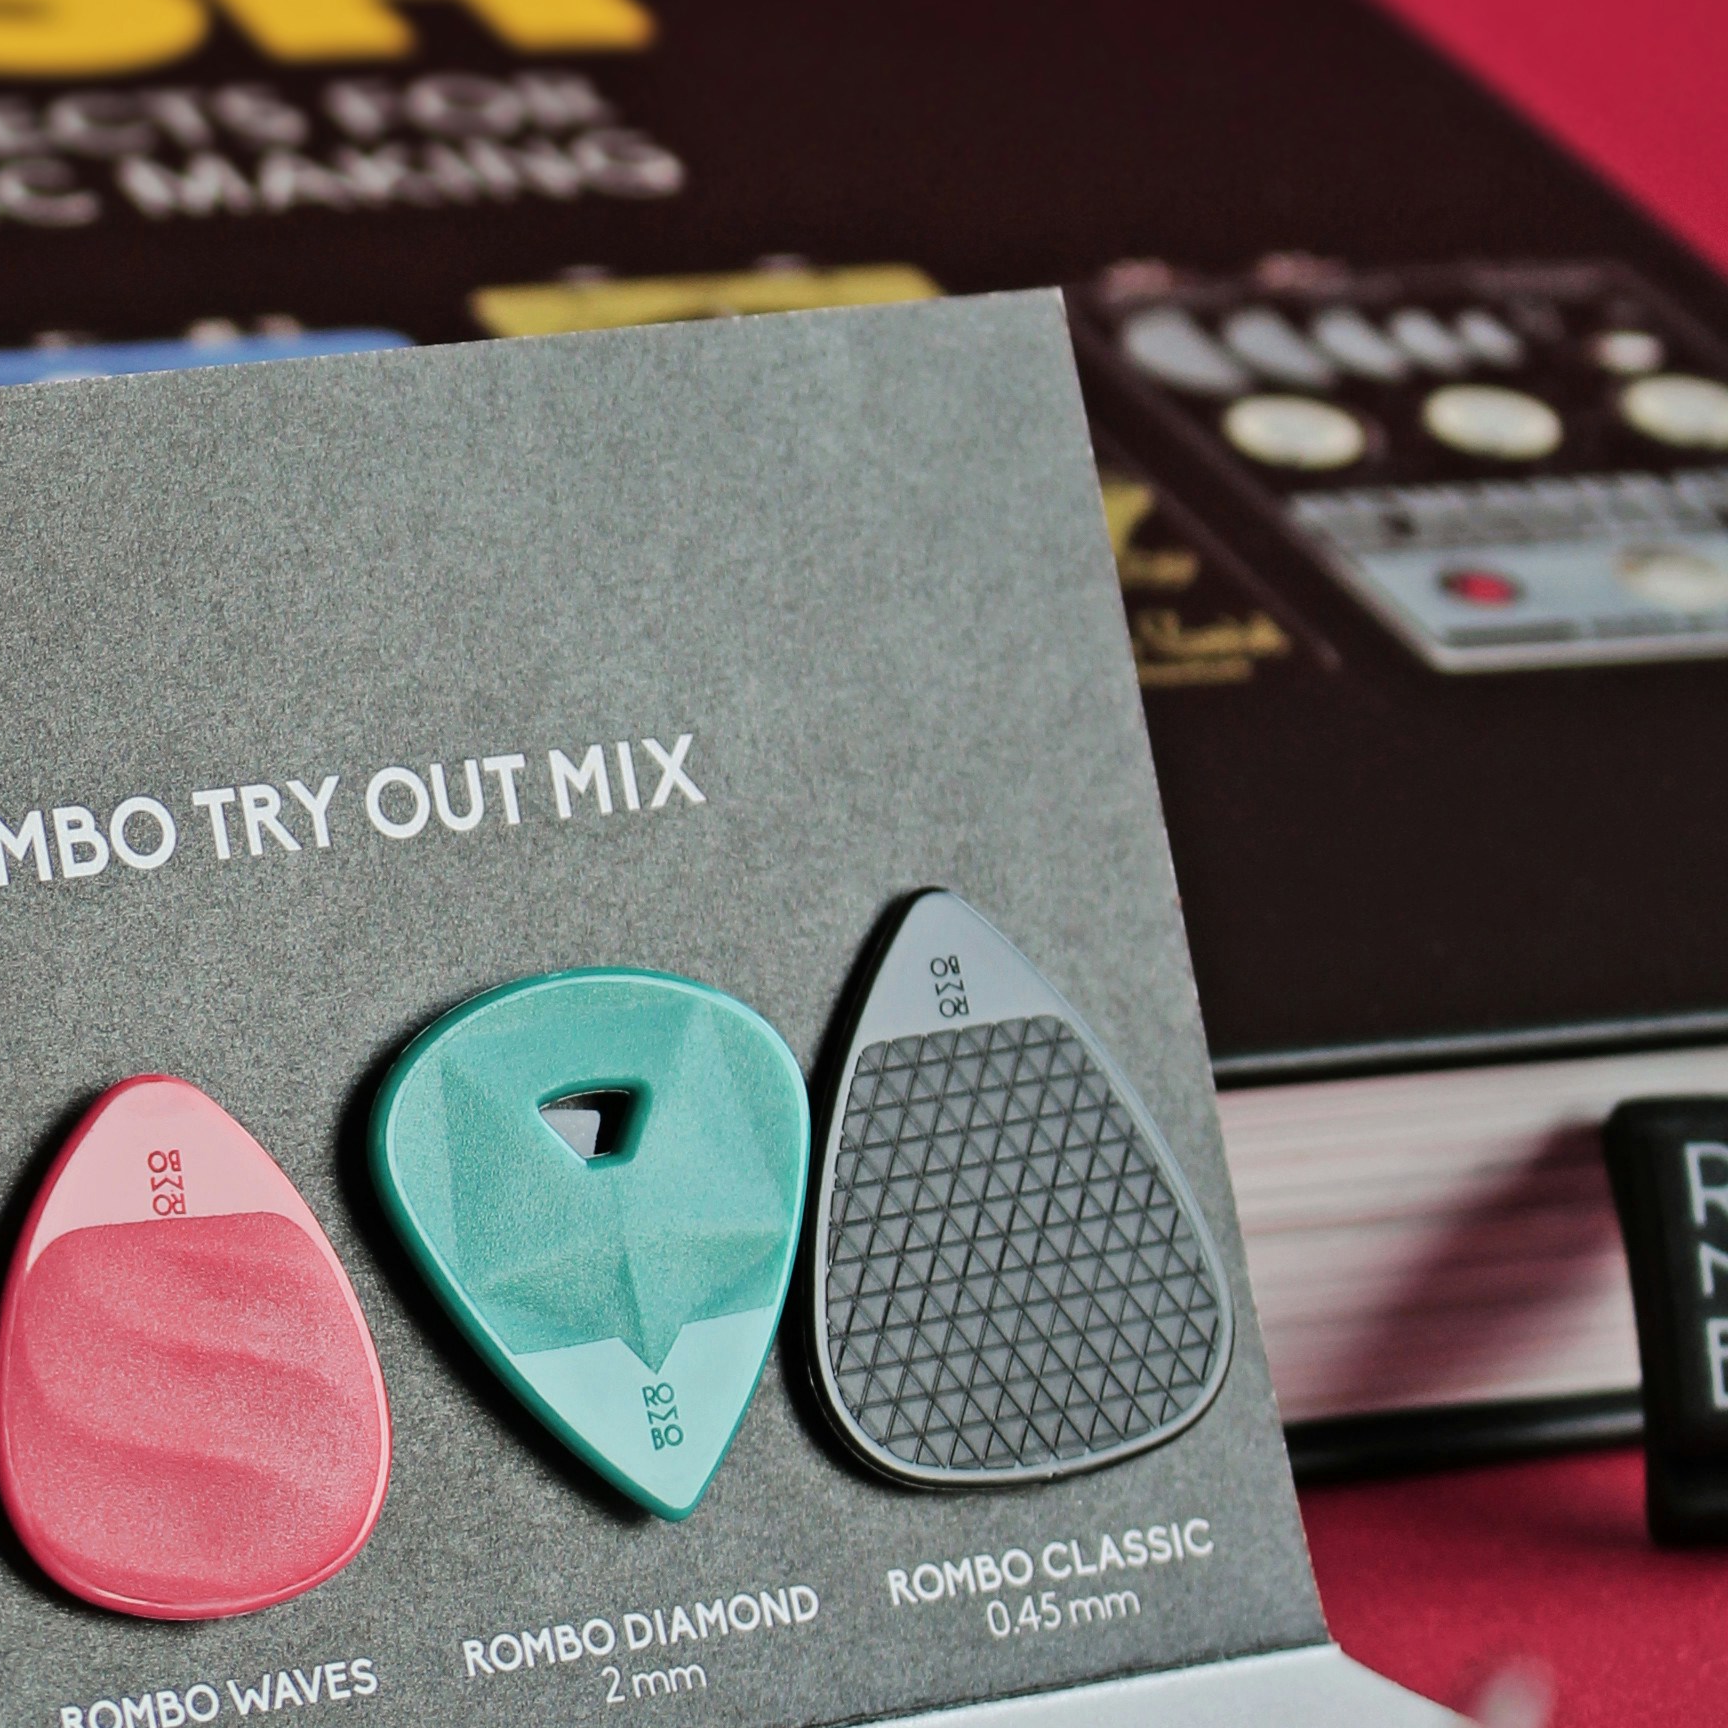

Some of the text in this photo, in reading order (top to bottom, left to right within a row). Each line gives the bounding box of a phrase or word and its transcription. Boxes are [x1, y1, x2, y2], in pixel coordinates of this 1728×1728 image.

[117, 126, 683, 219] MAKING
[192, 775, 340, 861] TRY
[364, 754, 526, 839] OUT
[549, 732, 707, 819] MIX
[887, 1519, 1214, 1606] ROMBO CLASSIC
[463, 1585, 820, 1677] ROMBO DIAMOND
[987, 1588, 1141, 1639] 0.45 mm
[235, 1658, 379, 1714] WAVES
[602, 1660, 707, 1703] 2 mm
